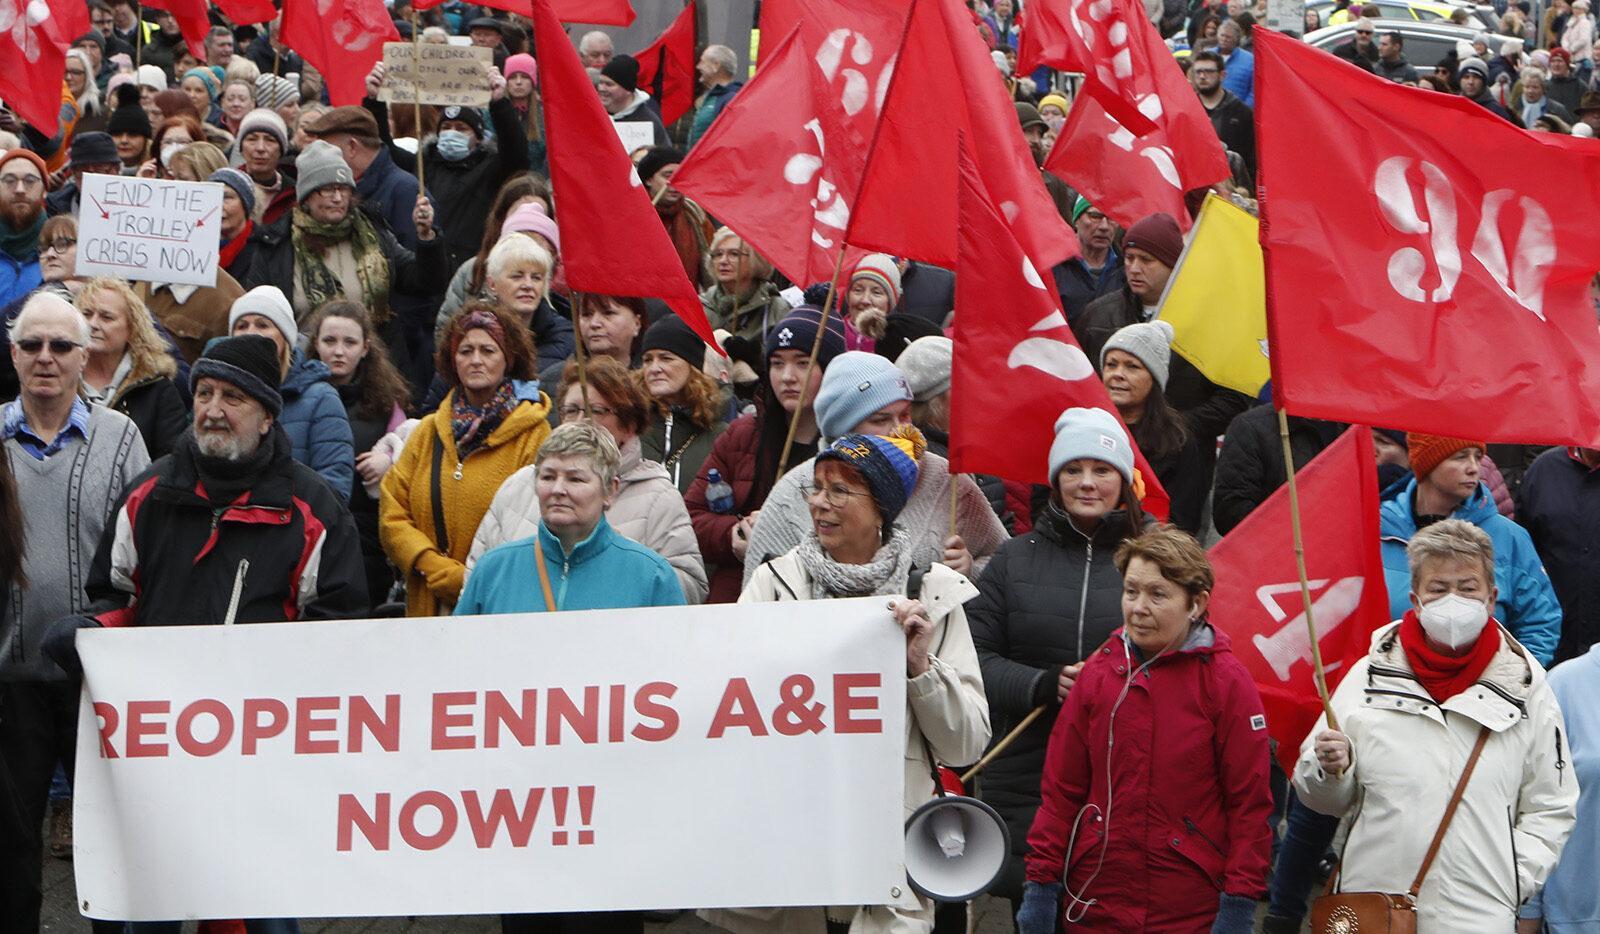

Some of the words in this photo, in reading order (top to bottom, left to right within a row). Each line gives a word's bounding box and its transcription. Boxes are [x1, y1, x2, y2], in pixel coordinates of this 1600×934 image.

[388, 64, 408, 73] ARE
[421, 47, 476, 60] CHILDREN
[103, 181, 153, 207] END
[159, 186, 205, 213] THE
[112, 211, 197, 242] TROLLEY
[85, 238, 149, 268] CRISIS
[160, 247, 212, 275] NOW
[93, 692, 402, 759] REOPEN
[430, 681, 681, 752] ENNIS
[707, 672, 883, 740] A&E
[336, 784, 596, 852] NOW!!
